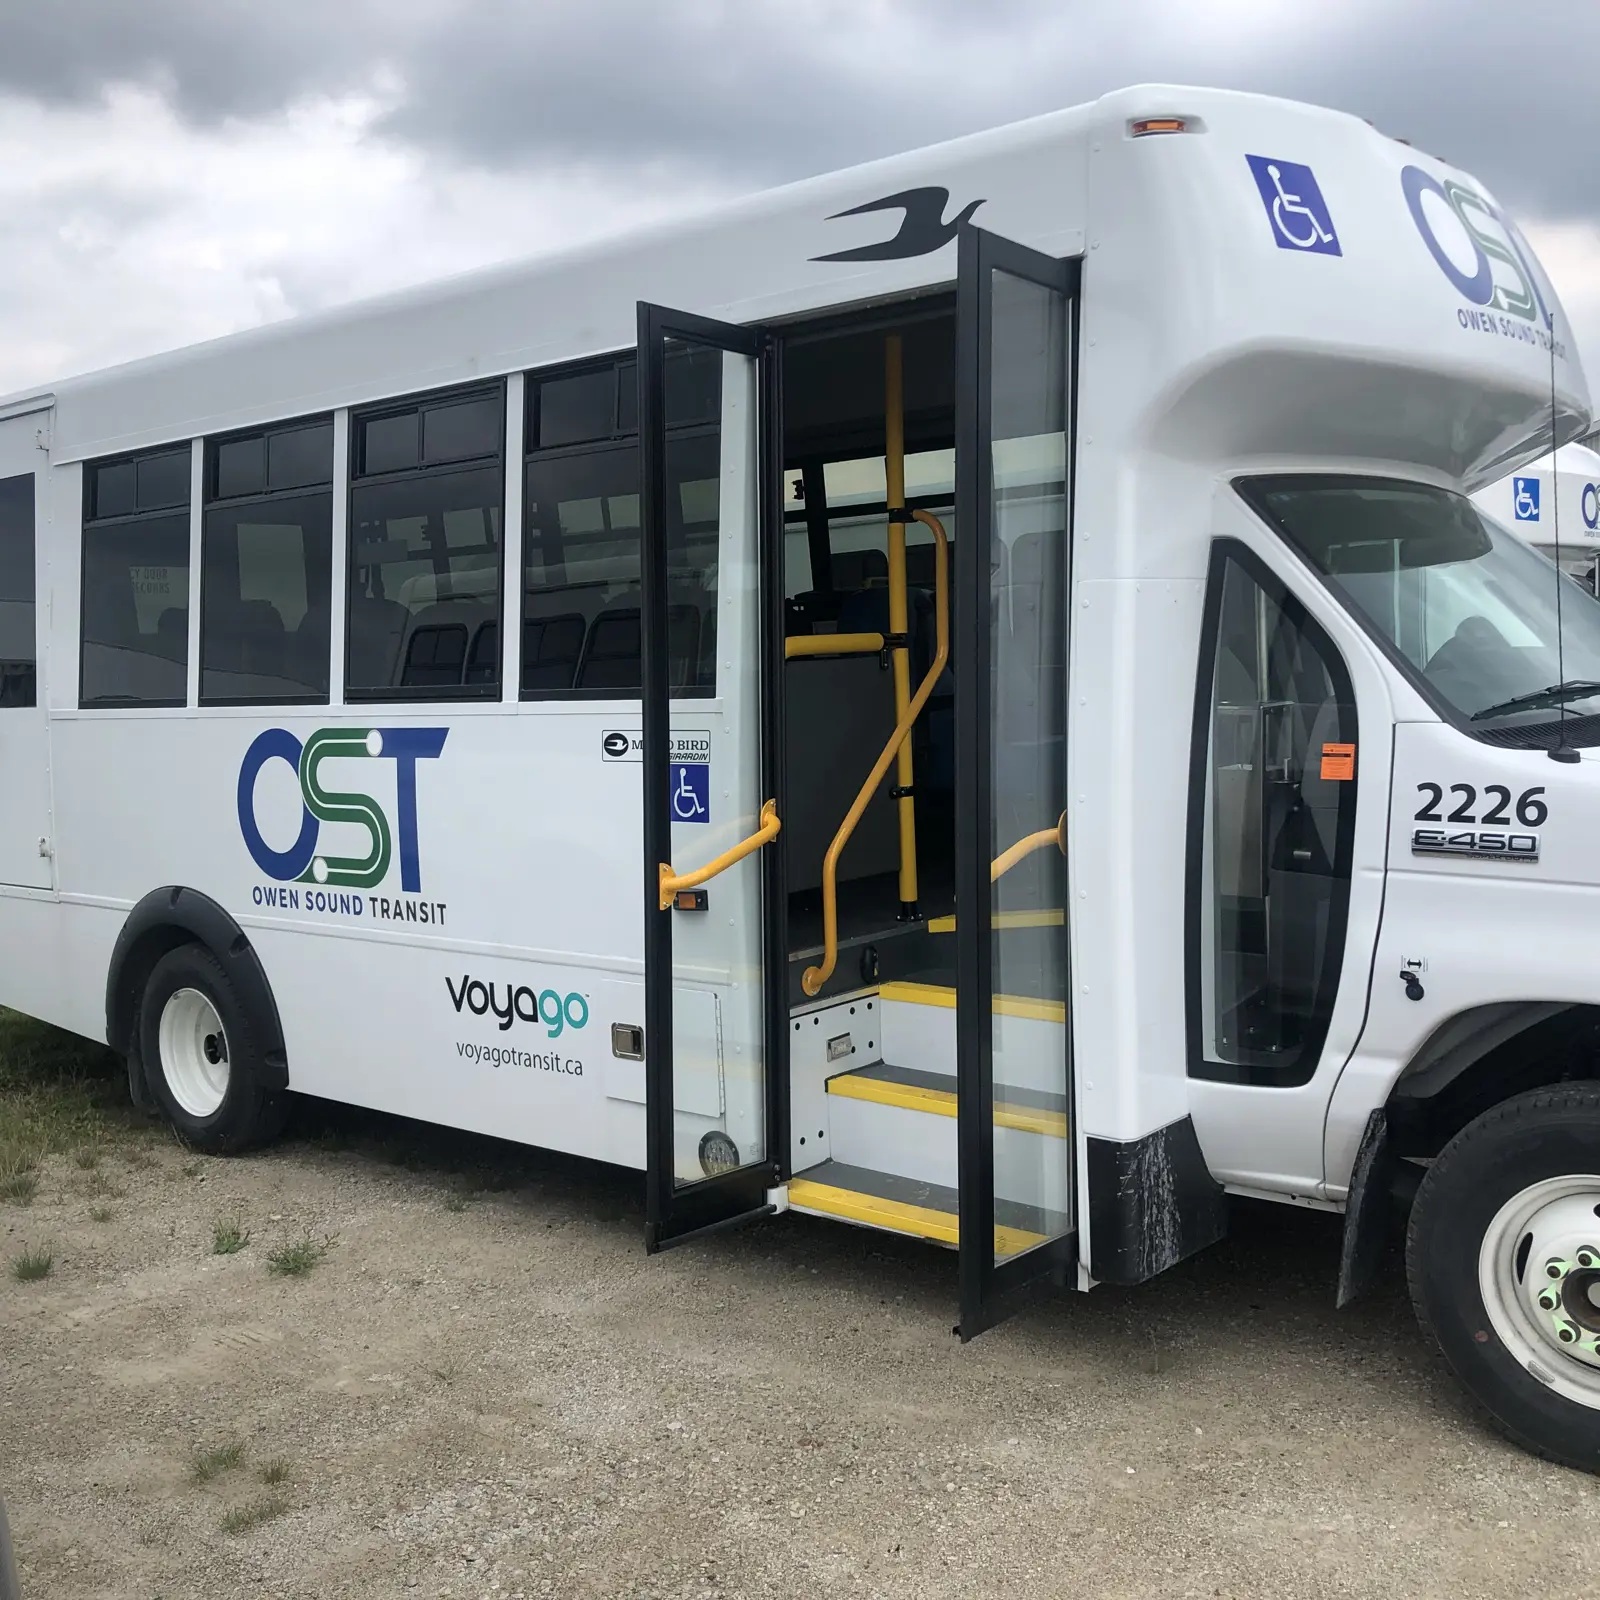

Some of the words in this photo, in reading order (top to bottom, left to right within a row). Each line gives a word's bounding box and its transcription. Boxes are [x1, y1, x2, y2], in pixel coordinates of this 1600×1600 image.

[1457, 308, 1499, 334] OWEN
[677, 739, 709, 751] BIRD
[237, 727, 450, 893] OST
[1414, 782, 1548, 827] 2226
[252, 885, 299, 909] OWEN
[305, 890, 363, 916] SOUND
[369, 896, 447, 925] TRANSIT
[456, 1042, 583, 1076] voyagotransit.ca
